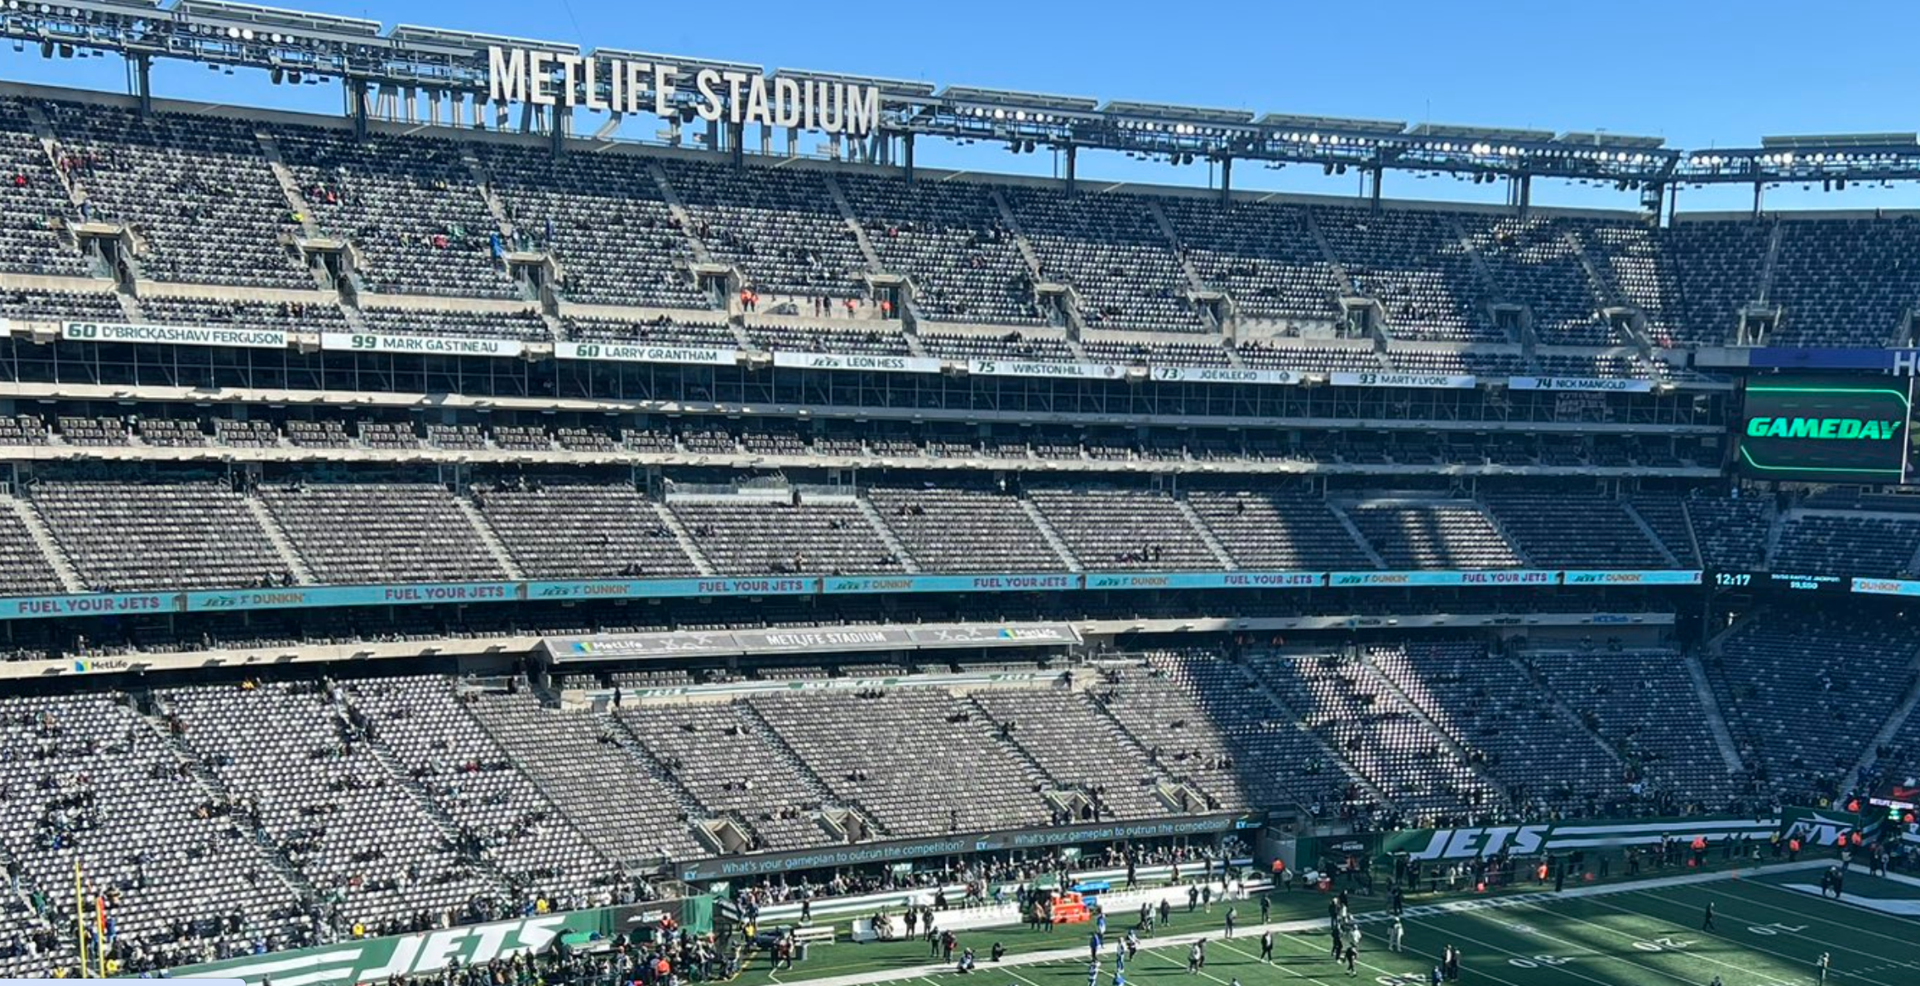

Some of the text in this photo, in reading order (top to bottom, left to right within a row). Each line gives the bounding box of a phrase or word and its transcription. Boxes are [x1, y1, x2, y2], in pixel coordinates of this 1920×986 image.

[489, 46, 879, 135] METLIFE STADIUM
[68, 324, 284, 344] 60 D'BRICKASHAW FERGUSON
[351, 335, 498, 353] 99 MARK GASTINEAU
[576, 344, 717, 361] 60 LARRY GRANTHAM
[846, 357, 875, 368] LEON
[877, 358, 905, 369] HESS
[978, 361, 1084, 375] 75 WINSTON HILL
[1161, 368, 1258, 381] 73 JOE KLECKO
[1360, 374, 1449, 386] 93 MARTY LYONS
[1535, 378, 1627, 389] 74 NICK MANGOLD
[1747, 417, 1901, 439] GAMEDAY
[974, 576, 1068, 588] FUEL YOUR JETS
[1224, 574, 1312, 585] FUEL YOUR JETS
[1462, 572, 1547, 582] FUEL YOUR JETS
[1715, 573, 1751, 586] 12:17
[698, 580, 803, 592] FUEL YOUR JETS
[385, 586, 504, 600] FUEL YOUR JETS
[18, 597, 160, 613] FUEL YOUR JETS
[593, 641, 643, 650] MetLife
[766, 631, 887, 647] METLIFE STADIUM
[91, 661, 128, 670] MetLife
[1015, 819, 1231, 845] What's your gameplan to outrun the competition?
[976, 841, 987, 850] EY
[1410, 825, 1549, 860] JETS
[721, 840, 965, 873] What's your gameplan to outrun the competition?
[684, 871, 697, 880] EY
[358, 916, 565, 980] JETS
